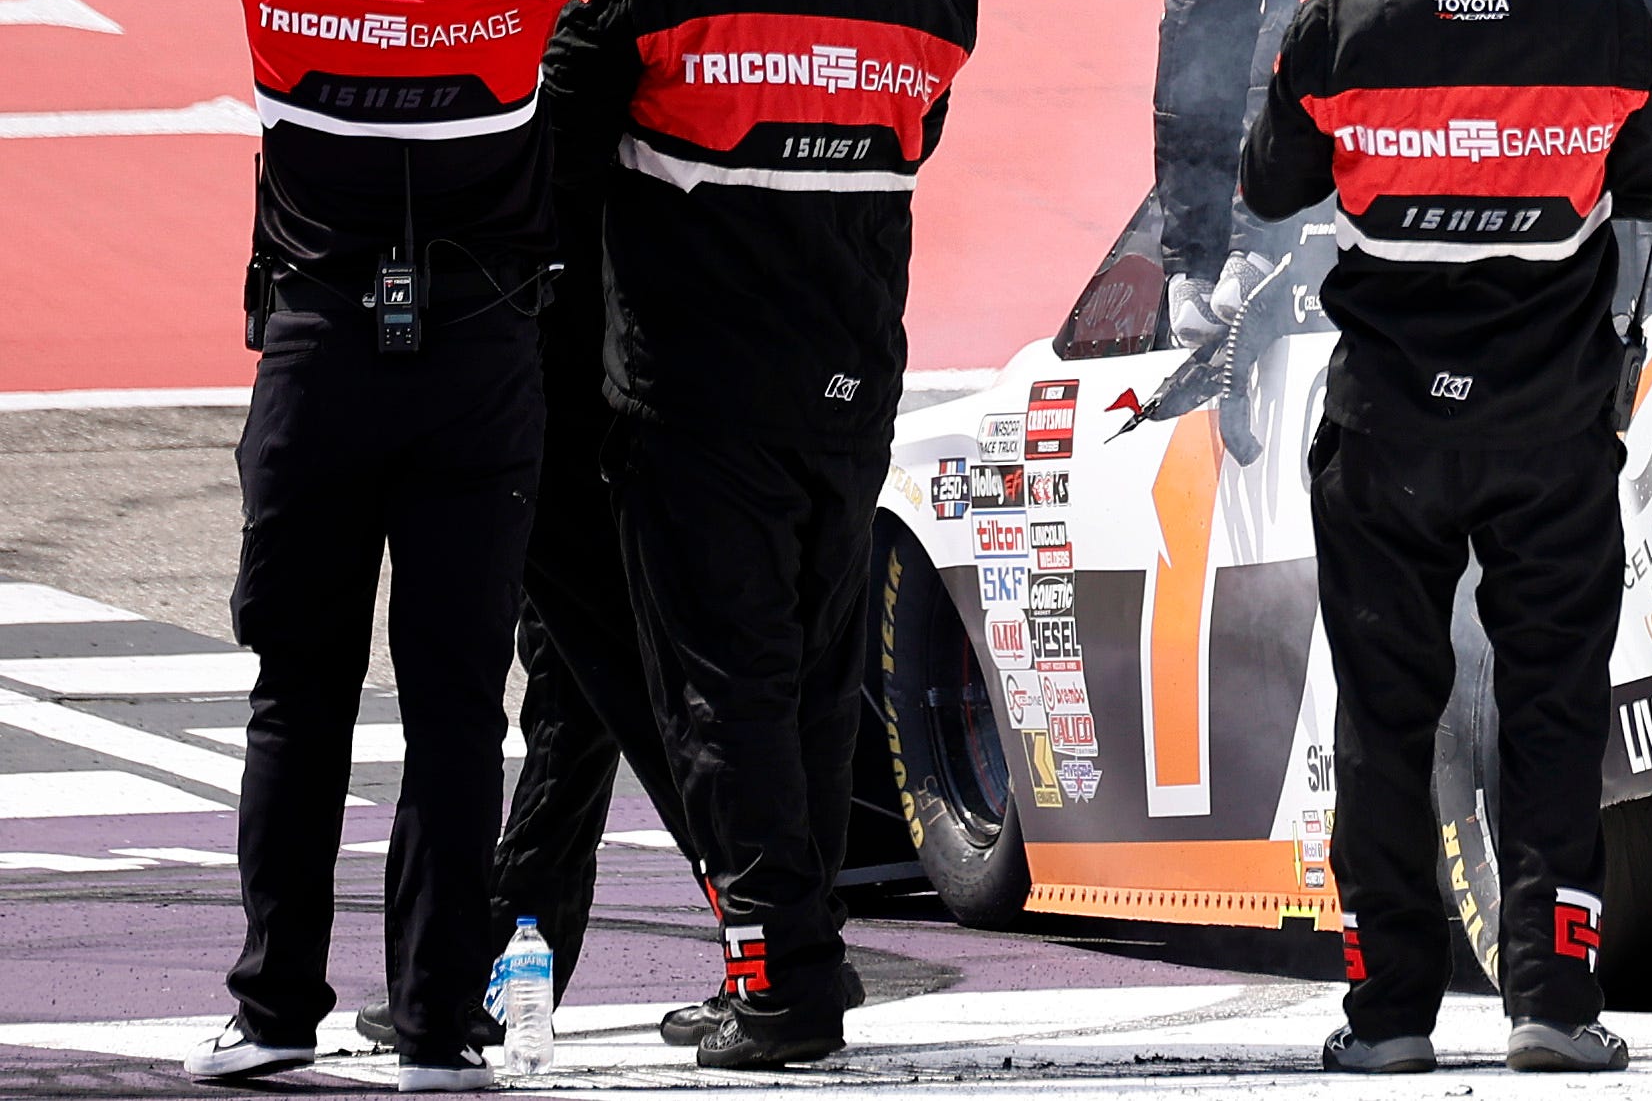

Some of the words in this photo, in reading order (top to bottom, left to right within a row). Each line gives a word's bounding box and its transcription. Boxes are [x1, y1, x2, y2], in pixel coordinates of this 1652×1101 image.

[259, 3, 362, 42] TRICON
[410, 9, 523, 48] GARAGE
[682, 52, 810, 85] TRICON
[335, 87, 358, 107] 5
[363, 87, 390, 108] 11
[394, 88, 425, 108] 15
[430, 86, 461, 108] 17
[782, 137, 794, 158] 1
[797, 137, 811, 158] 5
[812, 137, 826, 158] 11
[825, 139, 854, 159] 15
[1334, 125, 1446, 159] TRICON
[1503, 124, 1614, 157] GARAGE
[1401, 207, 1419, 228] 1
[1419, 209, 1446, 230] 5
[1446, 209, 1475, 231] 11
[1476, 210, 1508, 232] 15
[1510, 209, 1542, 232] 17
[1304, 296, 1322, 311] CELS
[1027, 408, 1074, 431] CRAFTSMAN
[999, 441, 1018, 453] TRUCK
[939, 476, 962, 500] 250
[971, 467, 1004, 505] Holley
[977, 519, 1024, 551] tilton
[1031, 524, 1066, 547] LINCOLN
[1038, 550, 1071, 568] WELDERS
[982, 566, 1025, 601] SKF
[1030, 582, 1074, 610] COMETIC
[1033, 621, 1081, 658] JESEL
[1055, 682, 1085, 704] brembo
[1051, 716, 1094, 746] CALICO
